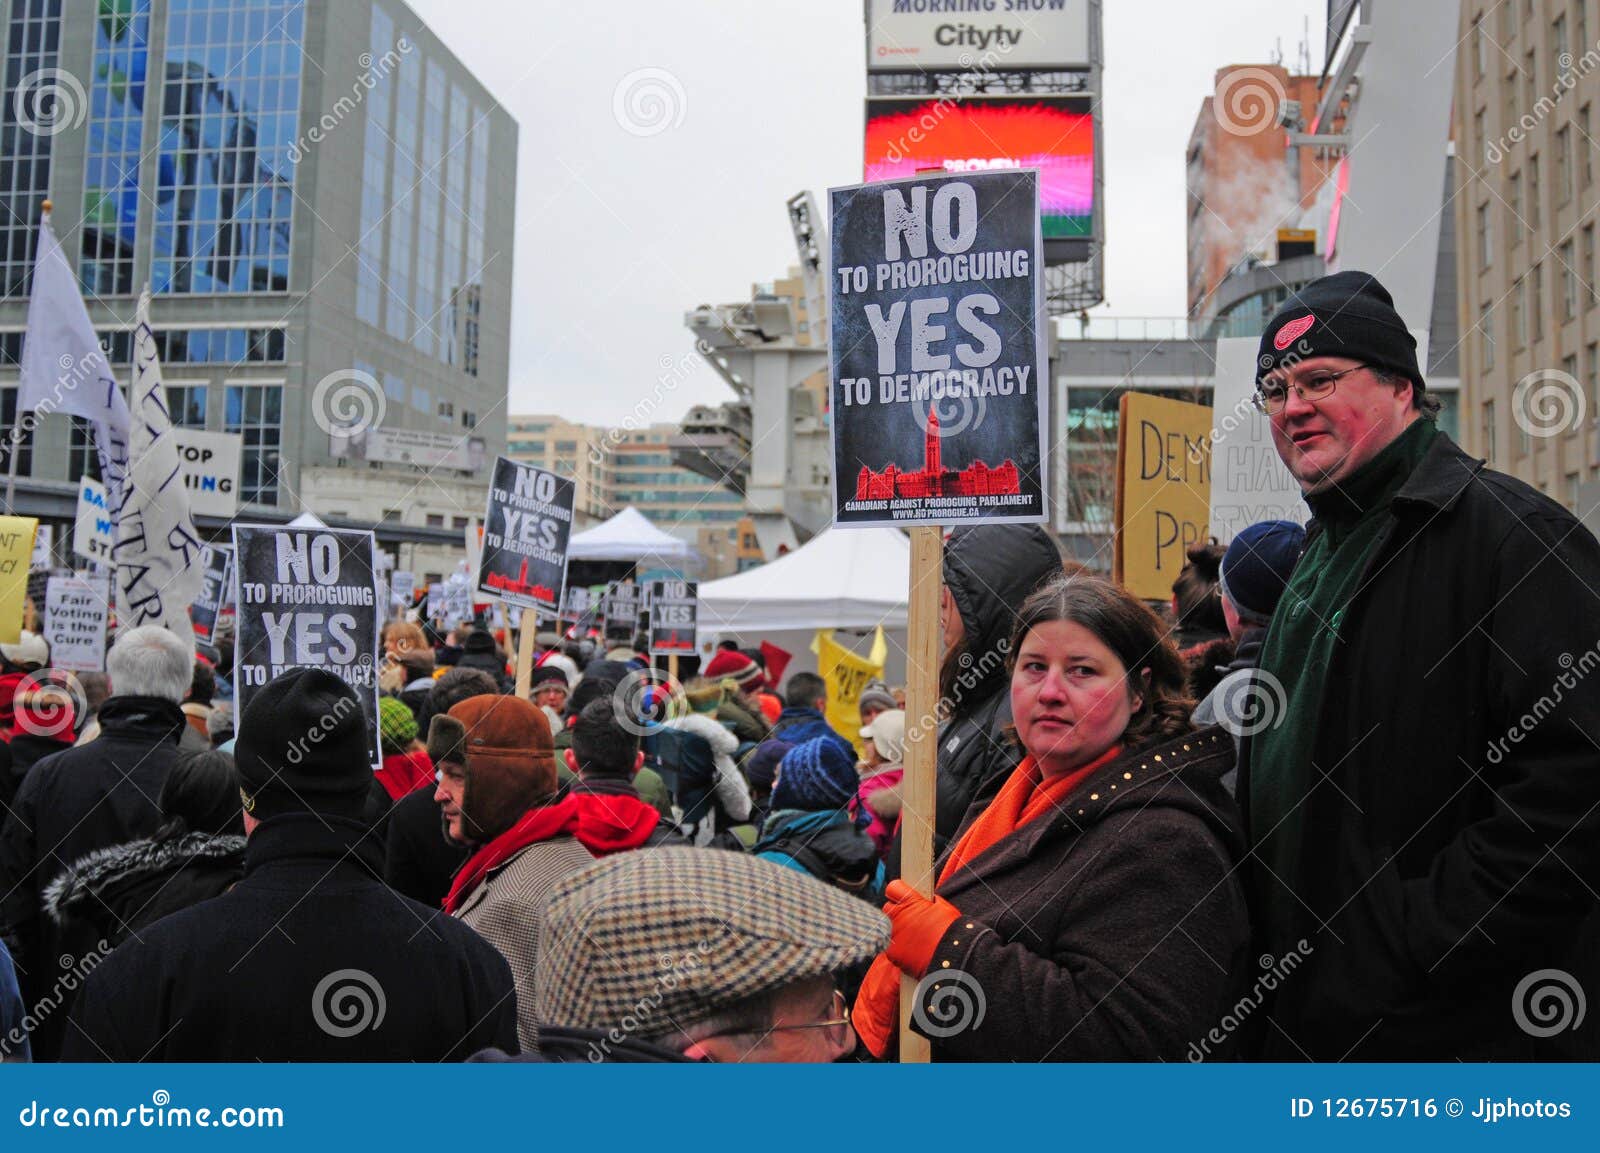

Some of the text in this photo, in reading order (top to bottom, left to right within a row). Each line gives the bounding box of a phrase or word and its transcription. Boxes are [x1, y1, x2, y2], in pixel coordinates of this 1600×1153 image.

[934, 23, 1022, 50] Citytv
[883, 182, 978, 261] NO
[838, 250, 1029, 294] TO PROROGUING
[863, 293, 1003, 375] YES
[839, 365, 1031, 406] TO DEMOCRACY
[513, 465, 556, 504] NO
[493, 488, 571, 522] TO PROROGUING
[845, 494, 1033, 512] CANADIANS AGAINST PROROGUING PARLIAMENT
[502, 506, 559, 550] YES
[275, 532, 340, 586] NO
[487, 532, 564, 567] TO DEMOCRACY
[60, 594, 93, 606] Fair
[243, 582, 374, 606] TO PROROGUING
[663, 581, 687, 599] NO
[50, 607, 103, 622] Voting
[52, 619, 98, 632] is the
[658, 605, 691, 622] YES
[54, 632, 94, 646] Cure
[262, 612, 358, 665] YES
[242, 664, 267, 686] TO
